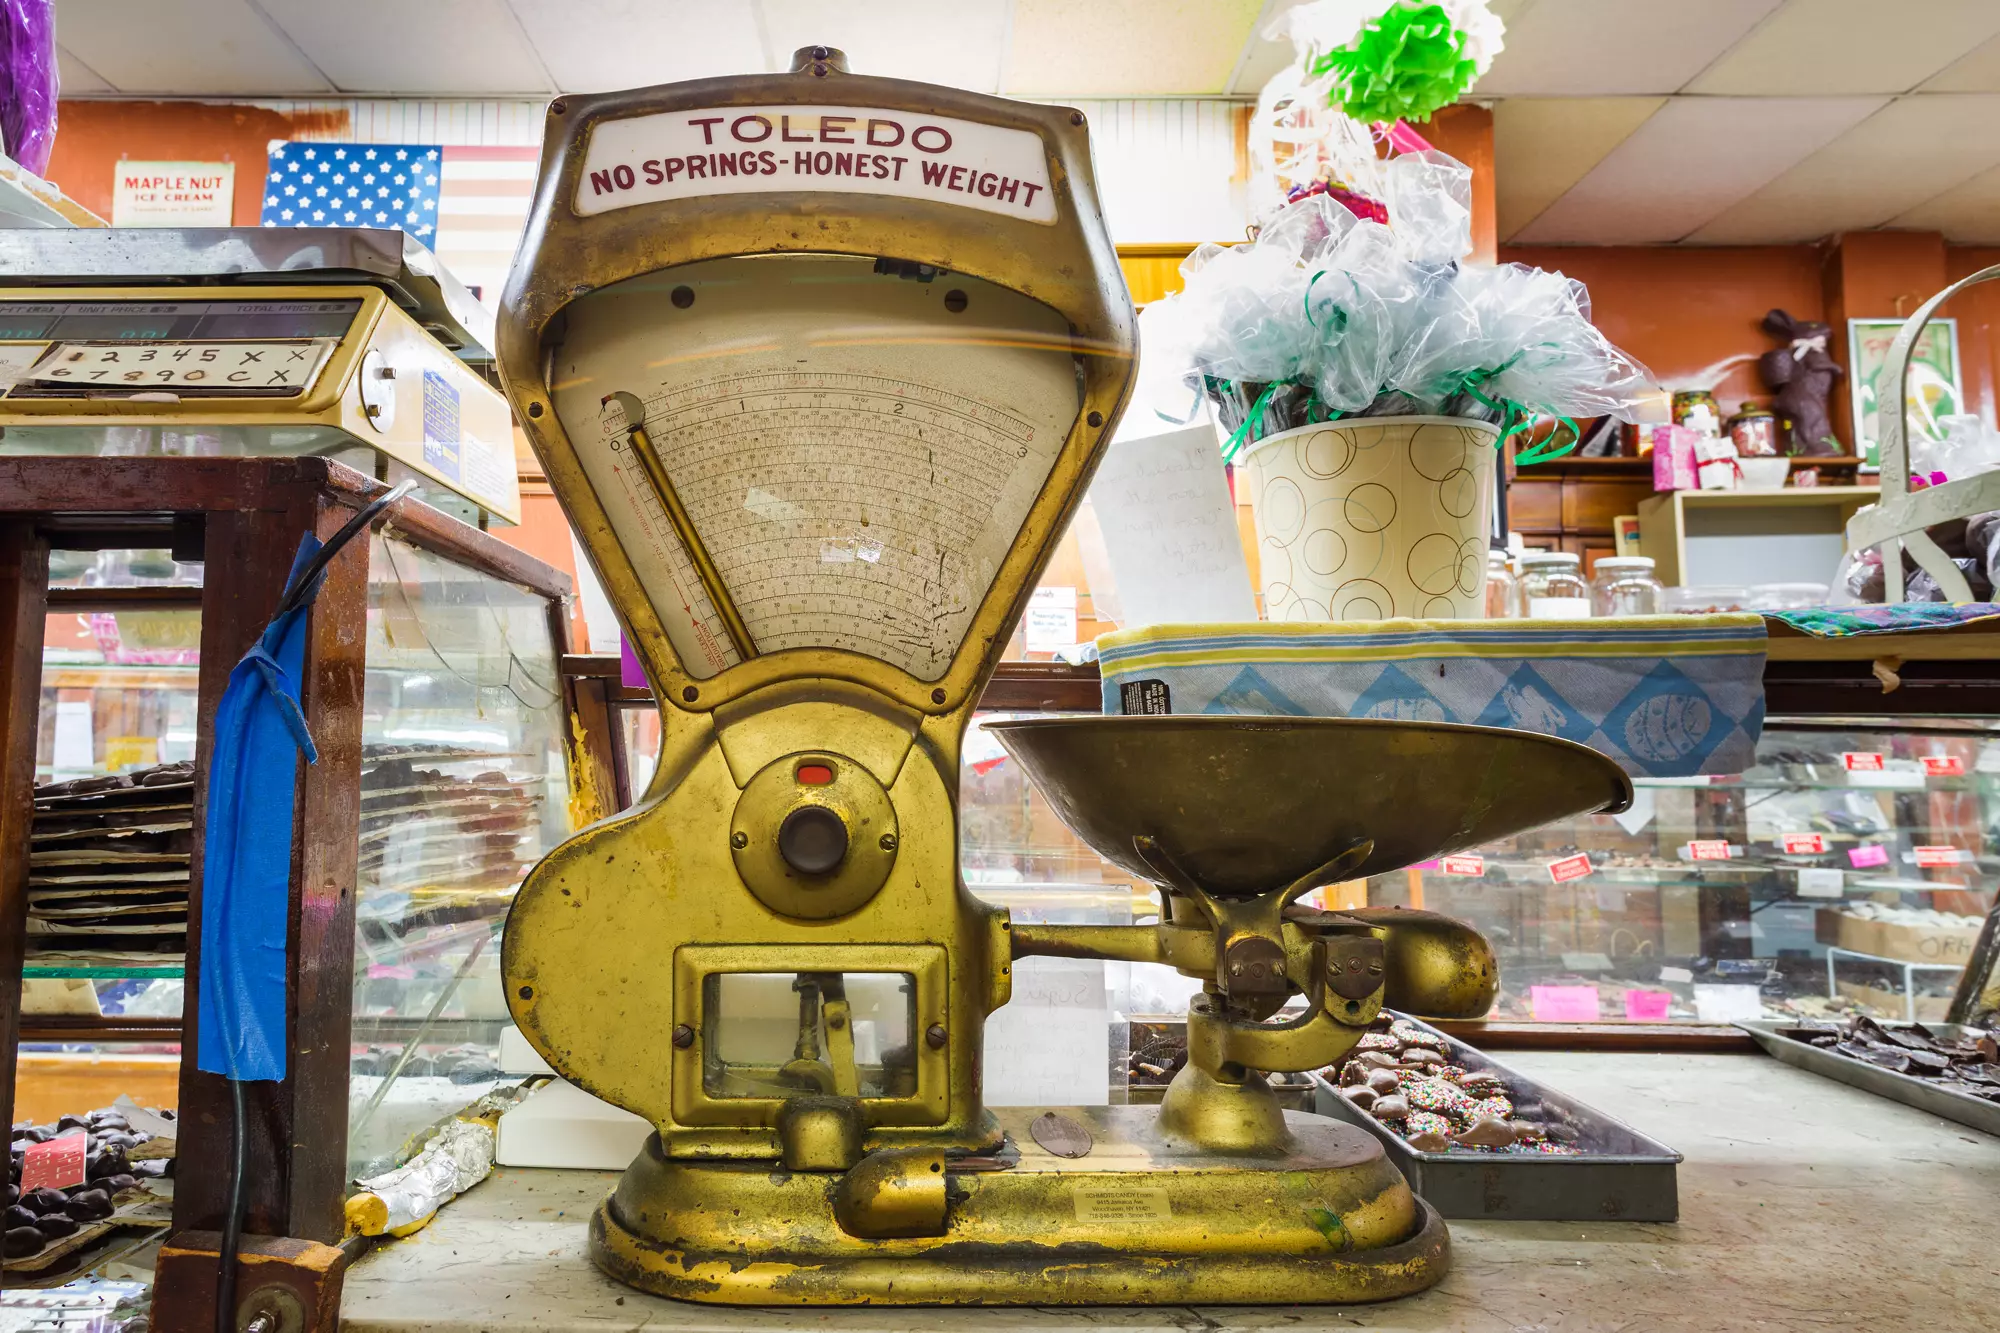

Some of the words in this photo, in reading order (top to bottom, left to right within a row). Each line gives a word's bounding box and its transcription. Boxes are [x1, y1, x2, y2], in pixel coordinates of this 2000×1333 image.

[688, 115, 952, 154] TOLEDO
[125, 177, 184, 190] MAPLE
[189, 176, 223, 190] NUT
[135, 193, 158, 201] ICE
[164, 193, 214, 201] CREAM
[590, 164, 636, 196] NO
[921, 160, 1043, 208] WEIGHT
[78, 306, 108, 314] UNIT
[110, 306, 147, 314] PRICE
[279, 304, 317, 312] PRICE
[101, 351, 120, 362] 2
[139, 350, 158, 361] 3
[173, 348, 192, 361] 4
[199, 349, 220, 362] 5
[239, 351, 265, 365] X
[287, 349, 308, 362] X
[51, 368, 71, 377] 6
[89, 370, 109, 380] 7
[123, 371, 144, 381] 8
[156, 370, 175, 382] 9
[227, 371, 252, 382] C
[267, 370, 290, 385] X
[736, 385, 743, 393] 2
[970, 408, 977, 416] 5
[1026, 433, 1033, 442] 6
[739, 400, 745, 411] 1
[893, 403, 904, 415] 2
[1017, 447, 1028, 458] 3
[700, 622, 726, 667] GRADUATIONS
